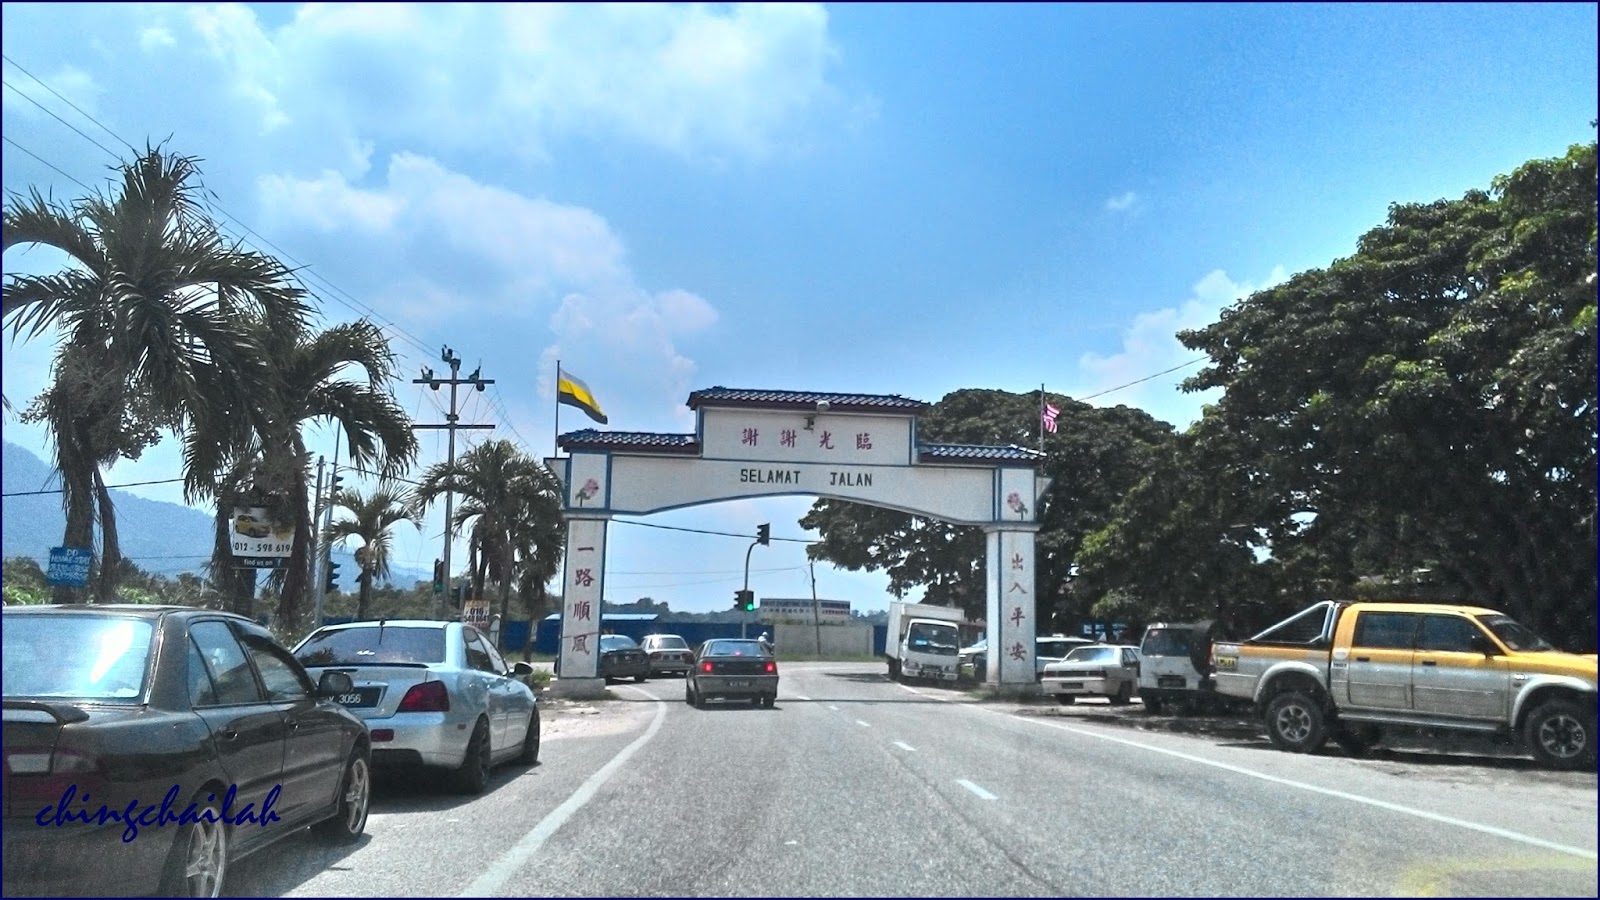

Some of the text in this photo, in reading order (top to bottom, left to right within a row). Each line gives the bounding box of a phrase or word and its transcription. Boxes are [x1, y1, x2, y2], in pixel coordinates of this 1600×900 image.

[742, 428, 873, 450] 謝謝光臨
[740, 469, 872, 486] SELAMAT JALAN
[235, 542, 248, 551] 012
[257, 543, 272, 552] 598
[243, 558, 255, 566] find
[572, 546, 595, 655] 一路順風
[1008, 553, 1028, 661] 出入平安
[339, 694, 361, 704] 3056
